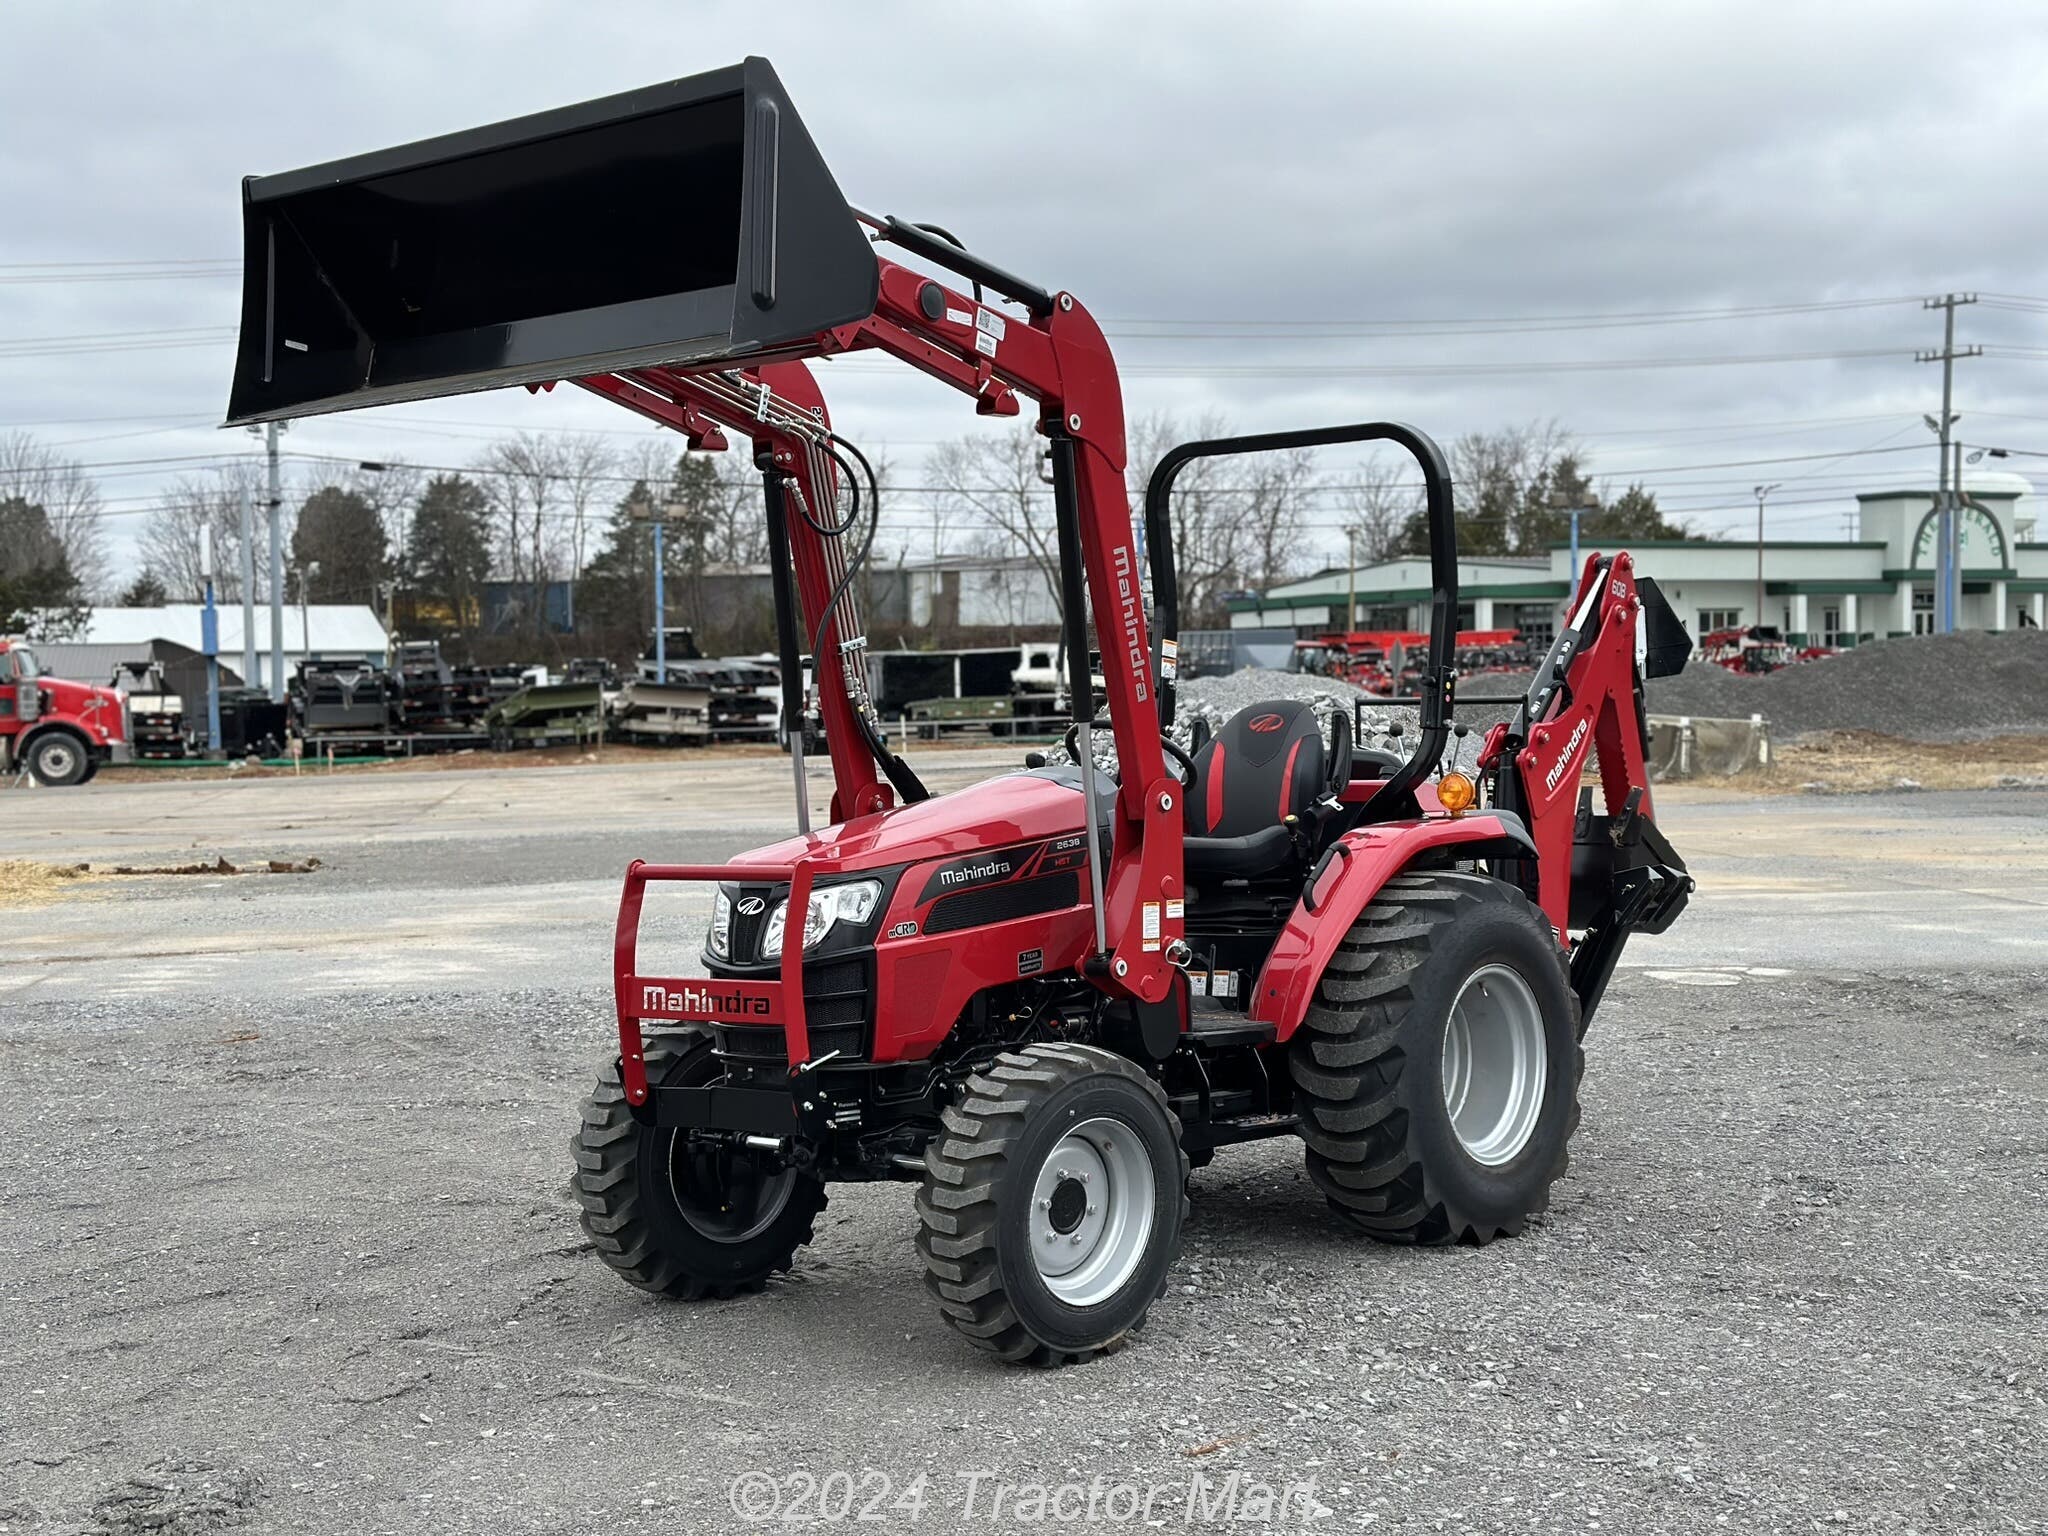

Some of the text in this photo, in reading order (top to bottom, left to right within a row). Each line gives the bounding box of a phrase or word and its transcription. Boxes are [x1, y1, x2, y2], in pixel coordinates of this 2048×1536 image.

[1545, 717, 1588, 792] Mahindra
[1056, 838, 1081, 850] 2638
[940, 861, 1011, 886] Mahindra
[643, 985, 770, 1015] Mahindra
